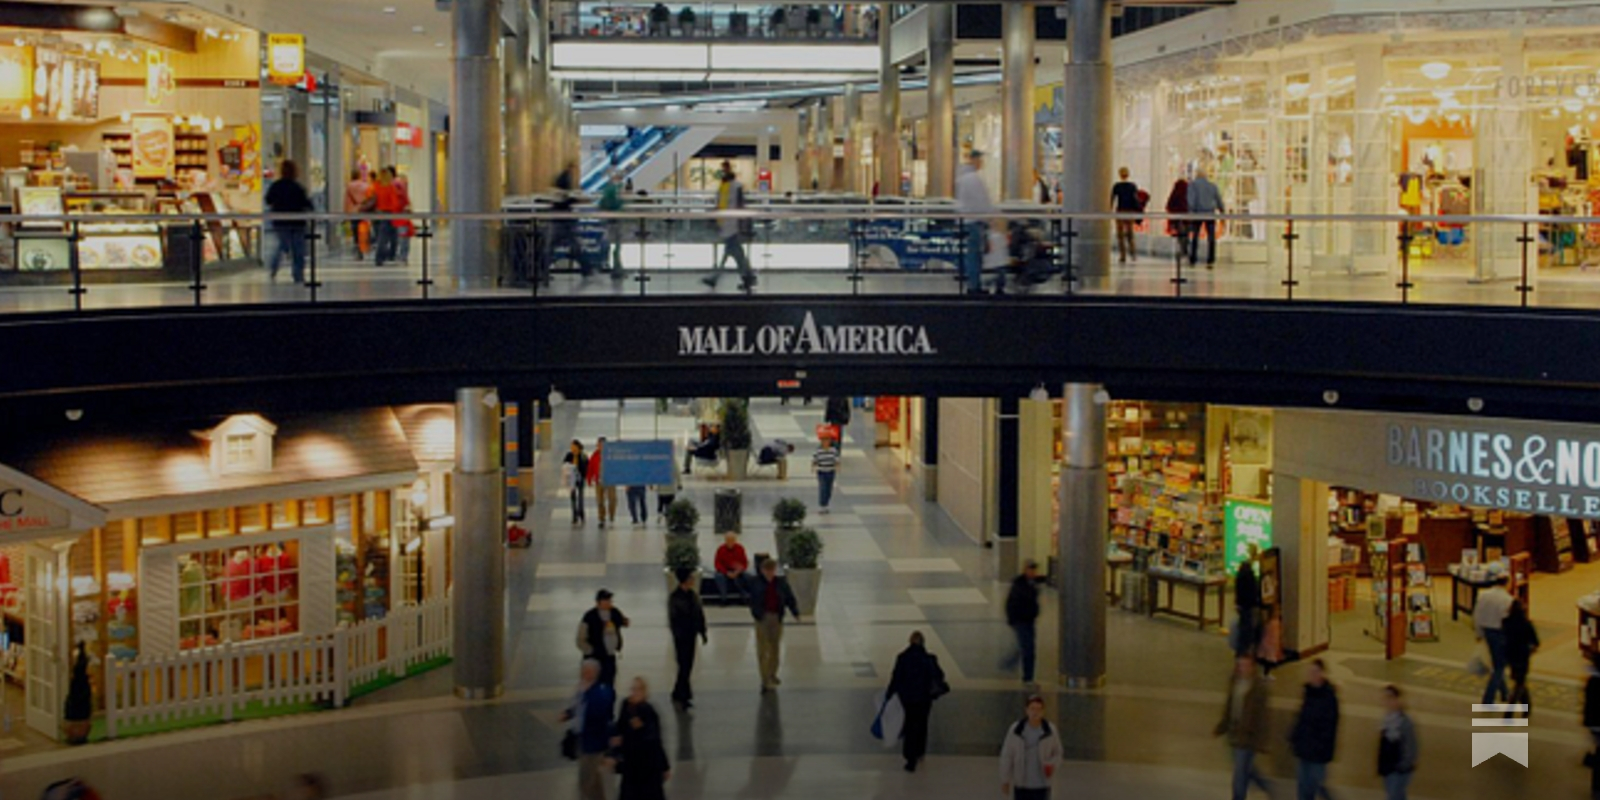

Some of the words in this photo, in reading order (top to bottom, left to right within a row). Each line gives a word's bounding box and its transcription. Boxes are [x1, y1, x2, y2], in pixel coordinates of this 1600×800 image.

[1495, 73, 1599, 98] FOREVER
[678, 326, 754, 355] MALL
[756, 325, 794, 354] OF
[793, 310, 937, 354] AMERICA
